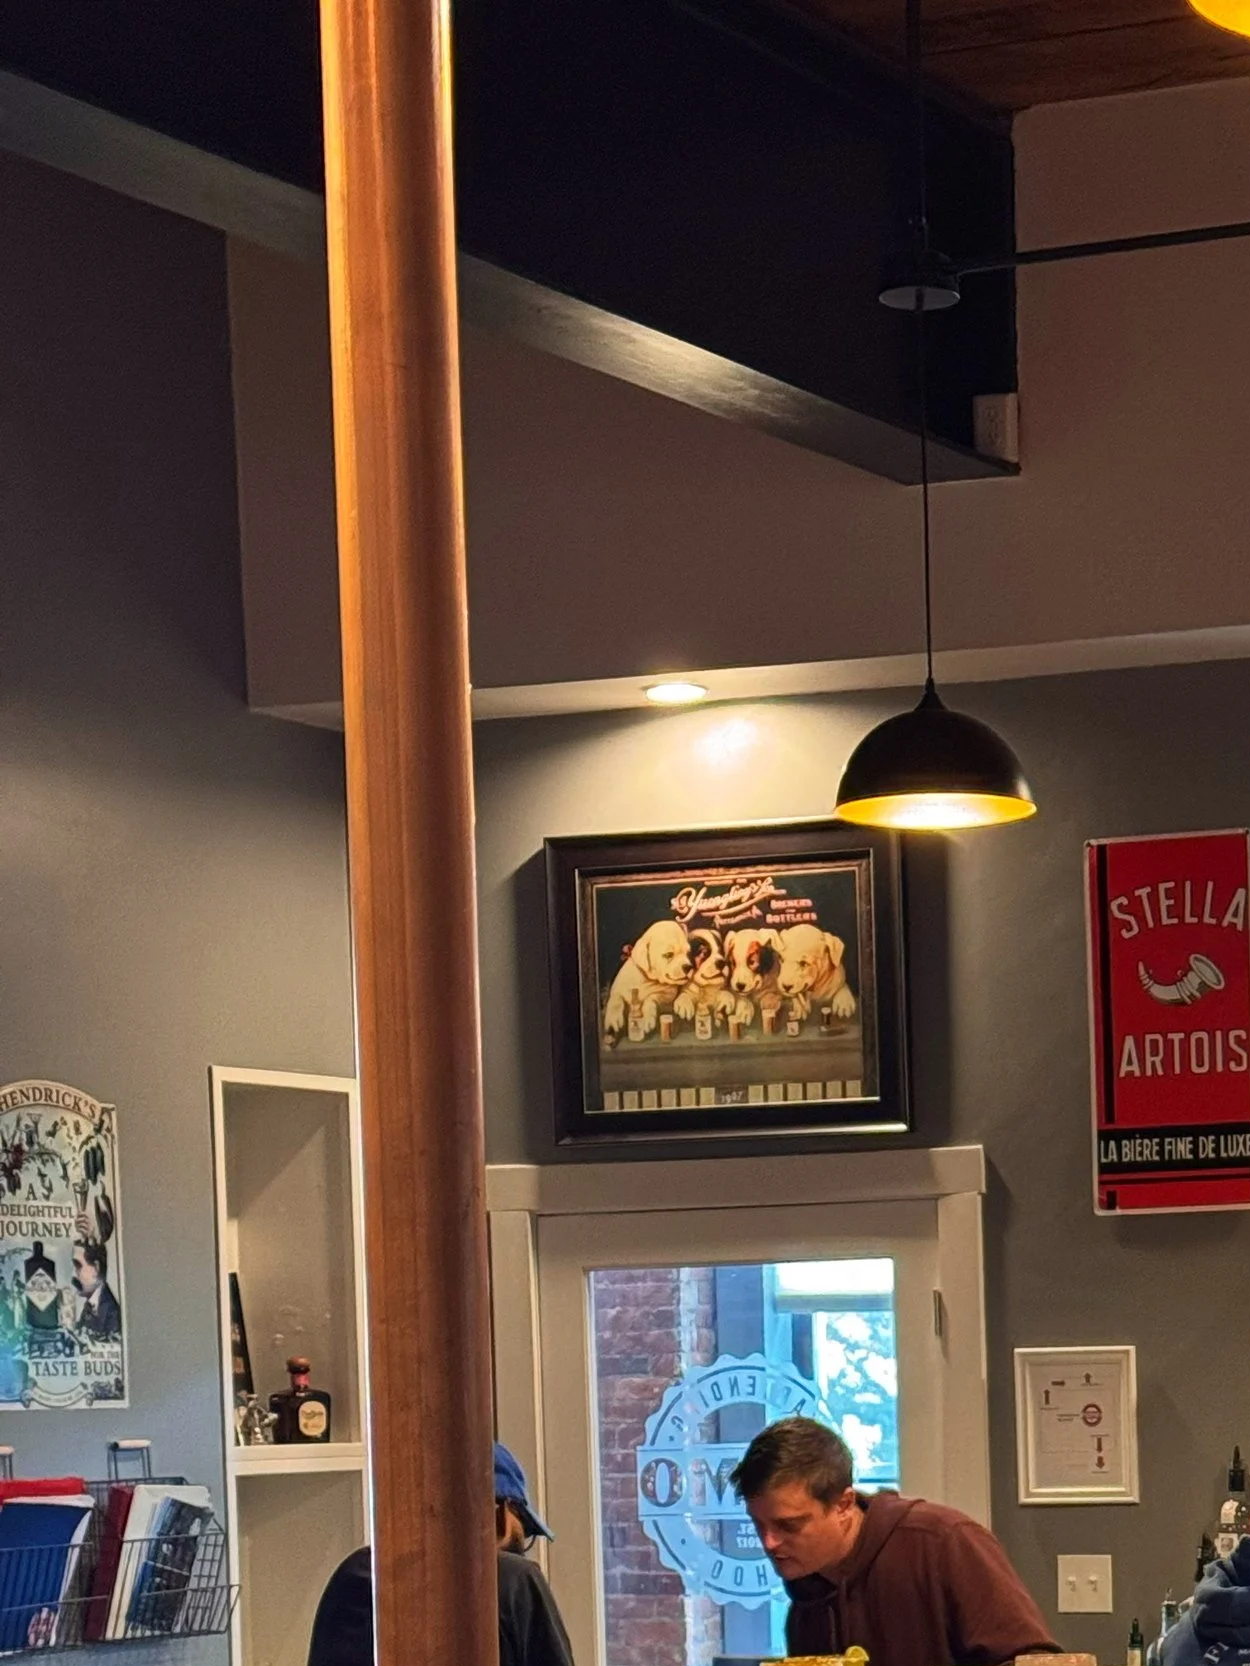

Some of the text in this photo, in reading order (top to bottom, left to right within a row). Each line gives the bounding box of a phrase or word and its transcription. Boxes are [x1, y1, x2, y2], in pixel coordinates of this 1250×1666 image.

[1110, 880, 1248, 940] STELLA
[1119, 1029, 1249, 1079] ARTOIS
[1100, 1139, 1118, 1163] LA
[1121, 1134, 1161, 1162] BIÈRE
[1164, 1136, 1194, 1160] FINE
[1199, 1135, 1217, 1158] DE
[25, 1183, 38, 1201] A
[0, 1203, 75, 1219] DELIGHTFUL
[0, 1220, 73, 1238] JOURNEY
[32, 1361, 121, 1377] TASTE BUDS
